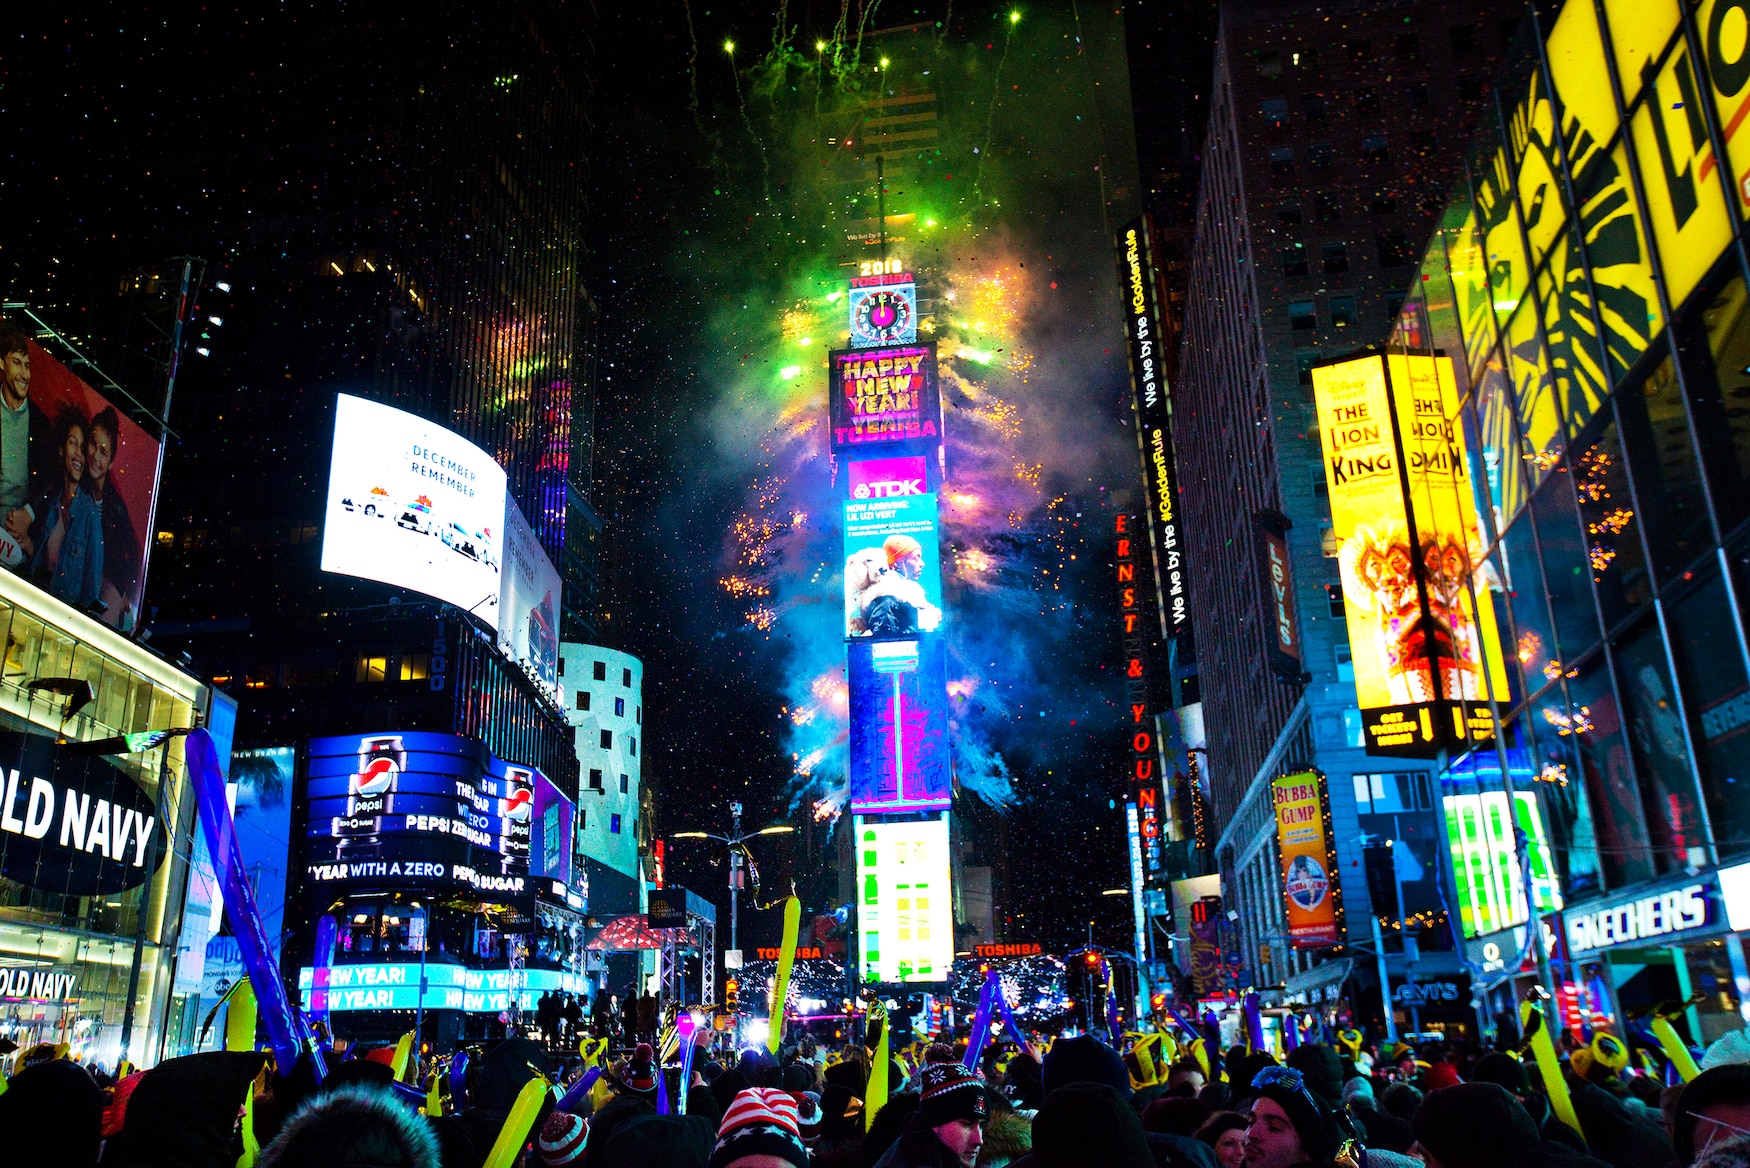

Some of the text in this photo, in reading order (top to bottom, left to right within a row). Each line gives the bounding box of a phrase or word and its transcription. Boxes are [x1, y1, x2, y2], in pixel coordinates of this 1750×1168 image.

[861, 260, 903, 276] 2018
[850, 272, 914, 288] TOSHIBA
[1125, 229, 1157, 408] We live by the #GoldenRule
[843, 355, 924, 380] HAPPY
[856, 374, 912, 397] NEW
[848, 390, 919, 415] YEAR!
[1333, 403, 1368, 422] THE
[1331, 424, 1381, 452] LION
[412, 444, 476, 482] DECEMBER
[1330, 454, 1392, 486] KING
[411, 461, 475, 499] REMEMBER
[868, 478, 923, 498] TDK
[1152, 428, 1186, 625] We live by the #GoldenRule
[1116, 514, 1137, 634] ERNST
[430, 621, 447, 692] 1500
[1127, 658, 1143, 678] &
[1369, 721, 1418, 736] TICKETS
[1380, 712, 1404, 724] GET
[1131, 704, 1159, 839] YOUNG
[1275, 783, 1316, 805] BUBBA
[355, 798, 383, 814] pepsi
[1281, 805, 1316, 825] GUMP
[59, 788, 155, 867] NAVY
[406, 815, 451, 834] PEPSI
[511, 825, 529, 837] pepsi
[311, 864, 348, 882] YEAR
[350, 862, 387, 878] WITH
[390, 862, 402, 877] A
[403, 862, 445, 877] ZERO
[480, 875, 525, 892] SUGAR
[1569, 884, 1706, 952] SKECHERS
[757, 947, 822, 960] TOSIBA
[976, 943, 1042, 957] TOSHIBA
[0, 967, 76, 1000] OLD NAVY
[215, 980, 231, 991] abc
[355, 967, 406, 985] YEAR!
[344, 989, 395, 1009] YEAR!
